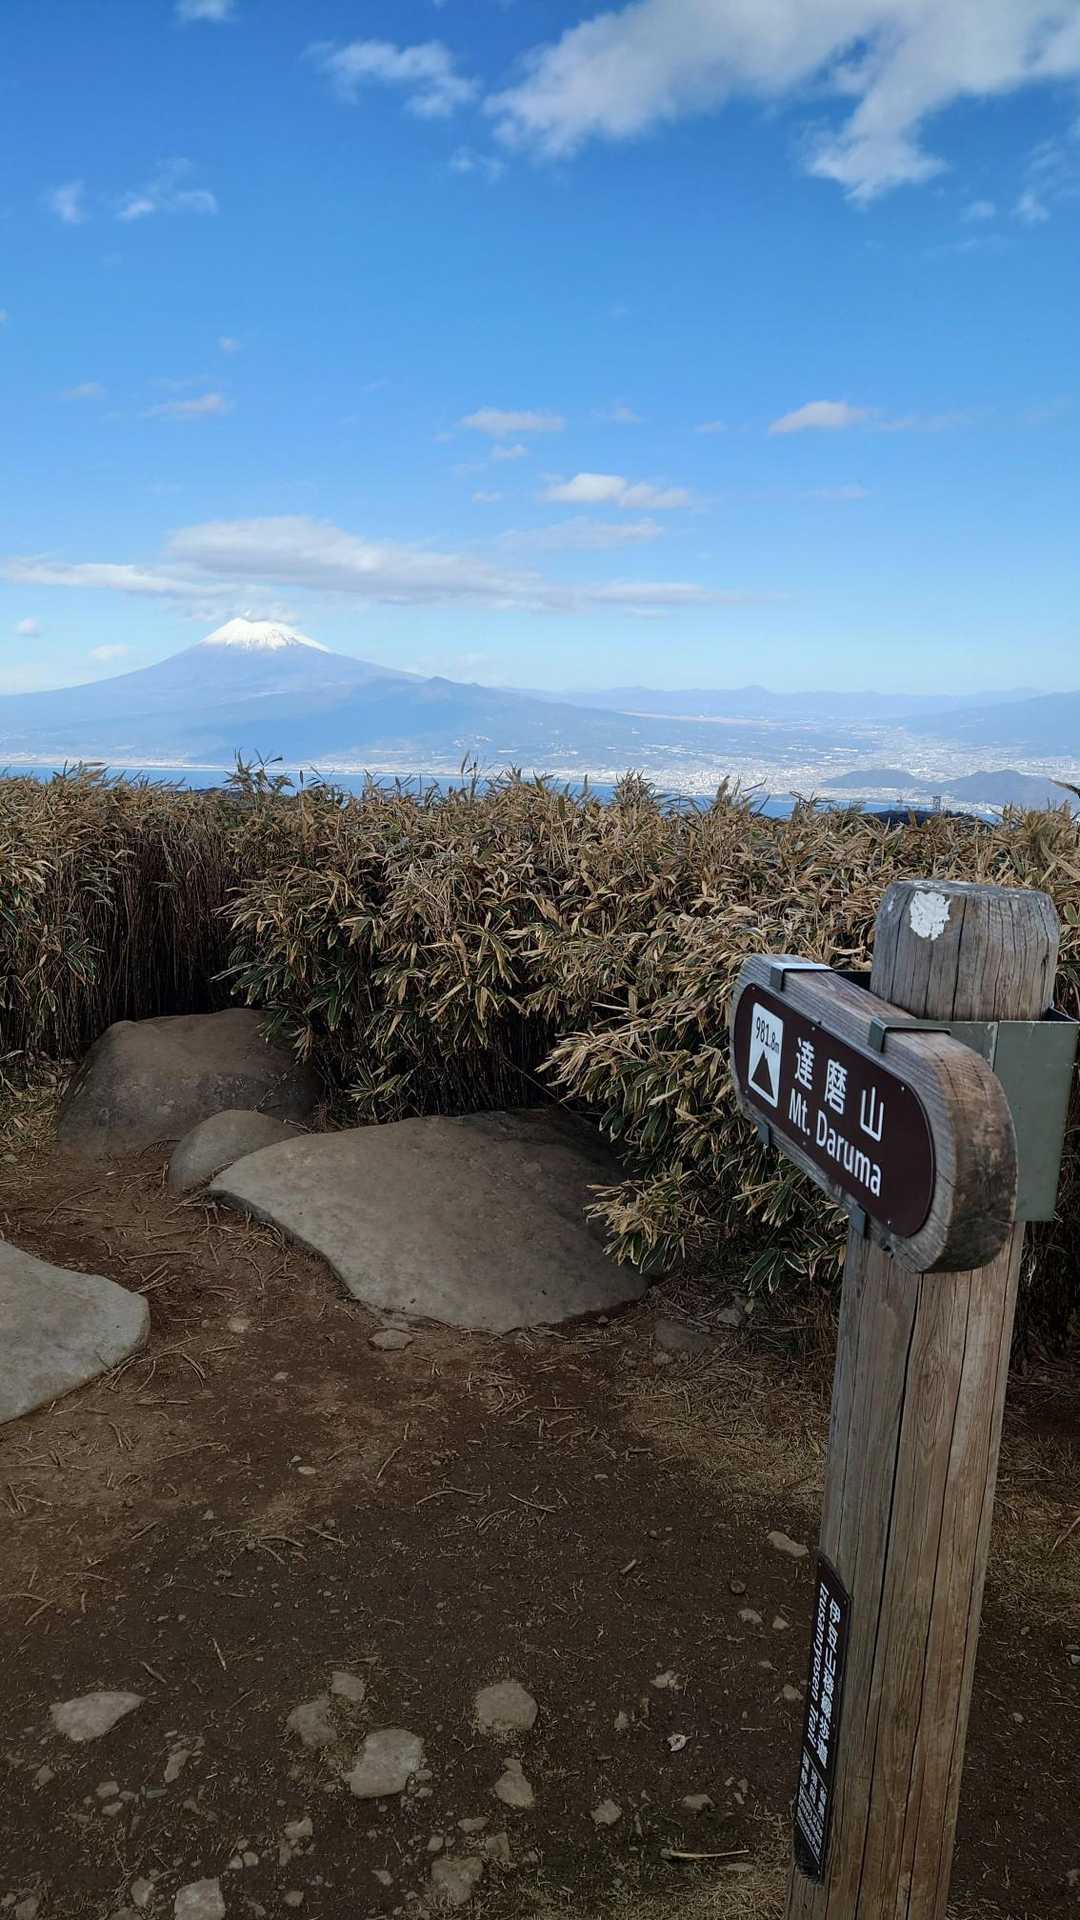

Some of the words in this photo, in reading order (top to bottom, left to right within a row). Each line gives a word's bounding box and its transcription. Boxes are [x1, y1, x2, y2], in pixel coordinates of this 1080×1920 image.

[756, 1016, 780, 1054] 981.8m
[794, 1036, 884, 1142] 達磨山
[788, 1088, 811, 1137] Mt.
[815, 1110, 882, 1197] Daruma
[807, 1703, 819, 1748] Trail
